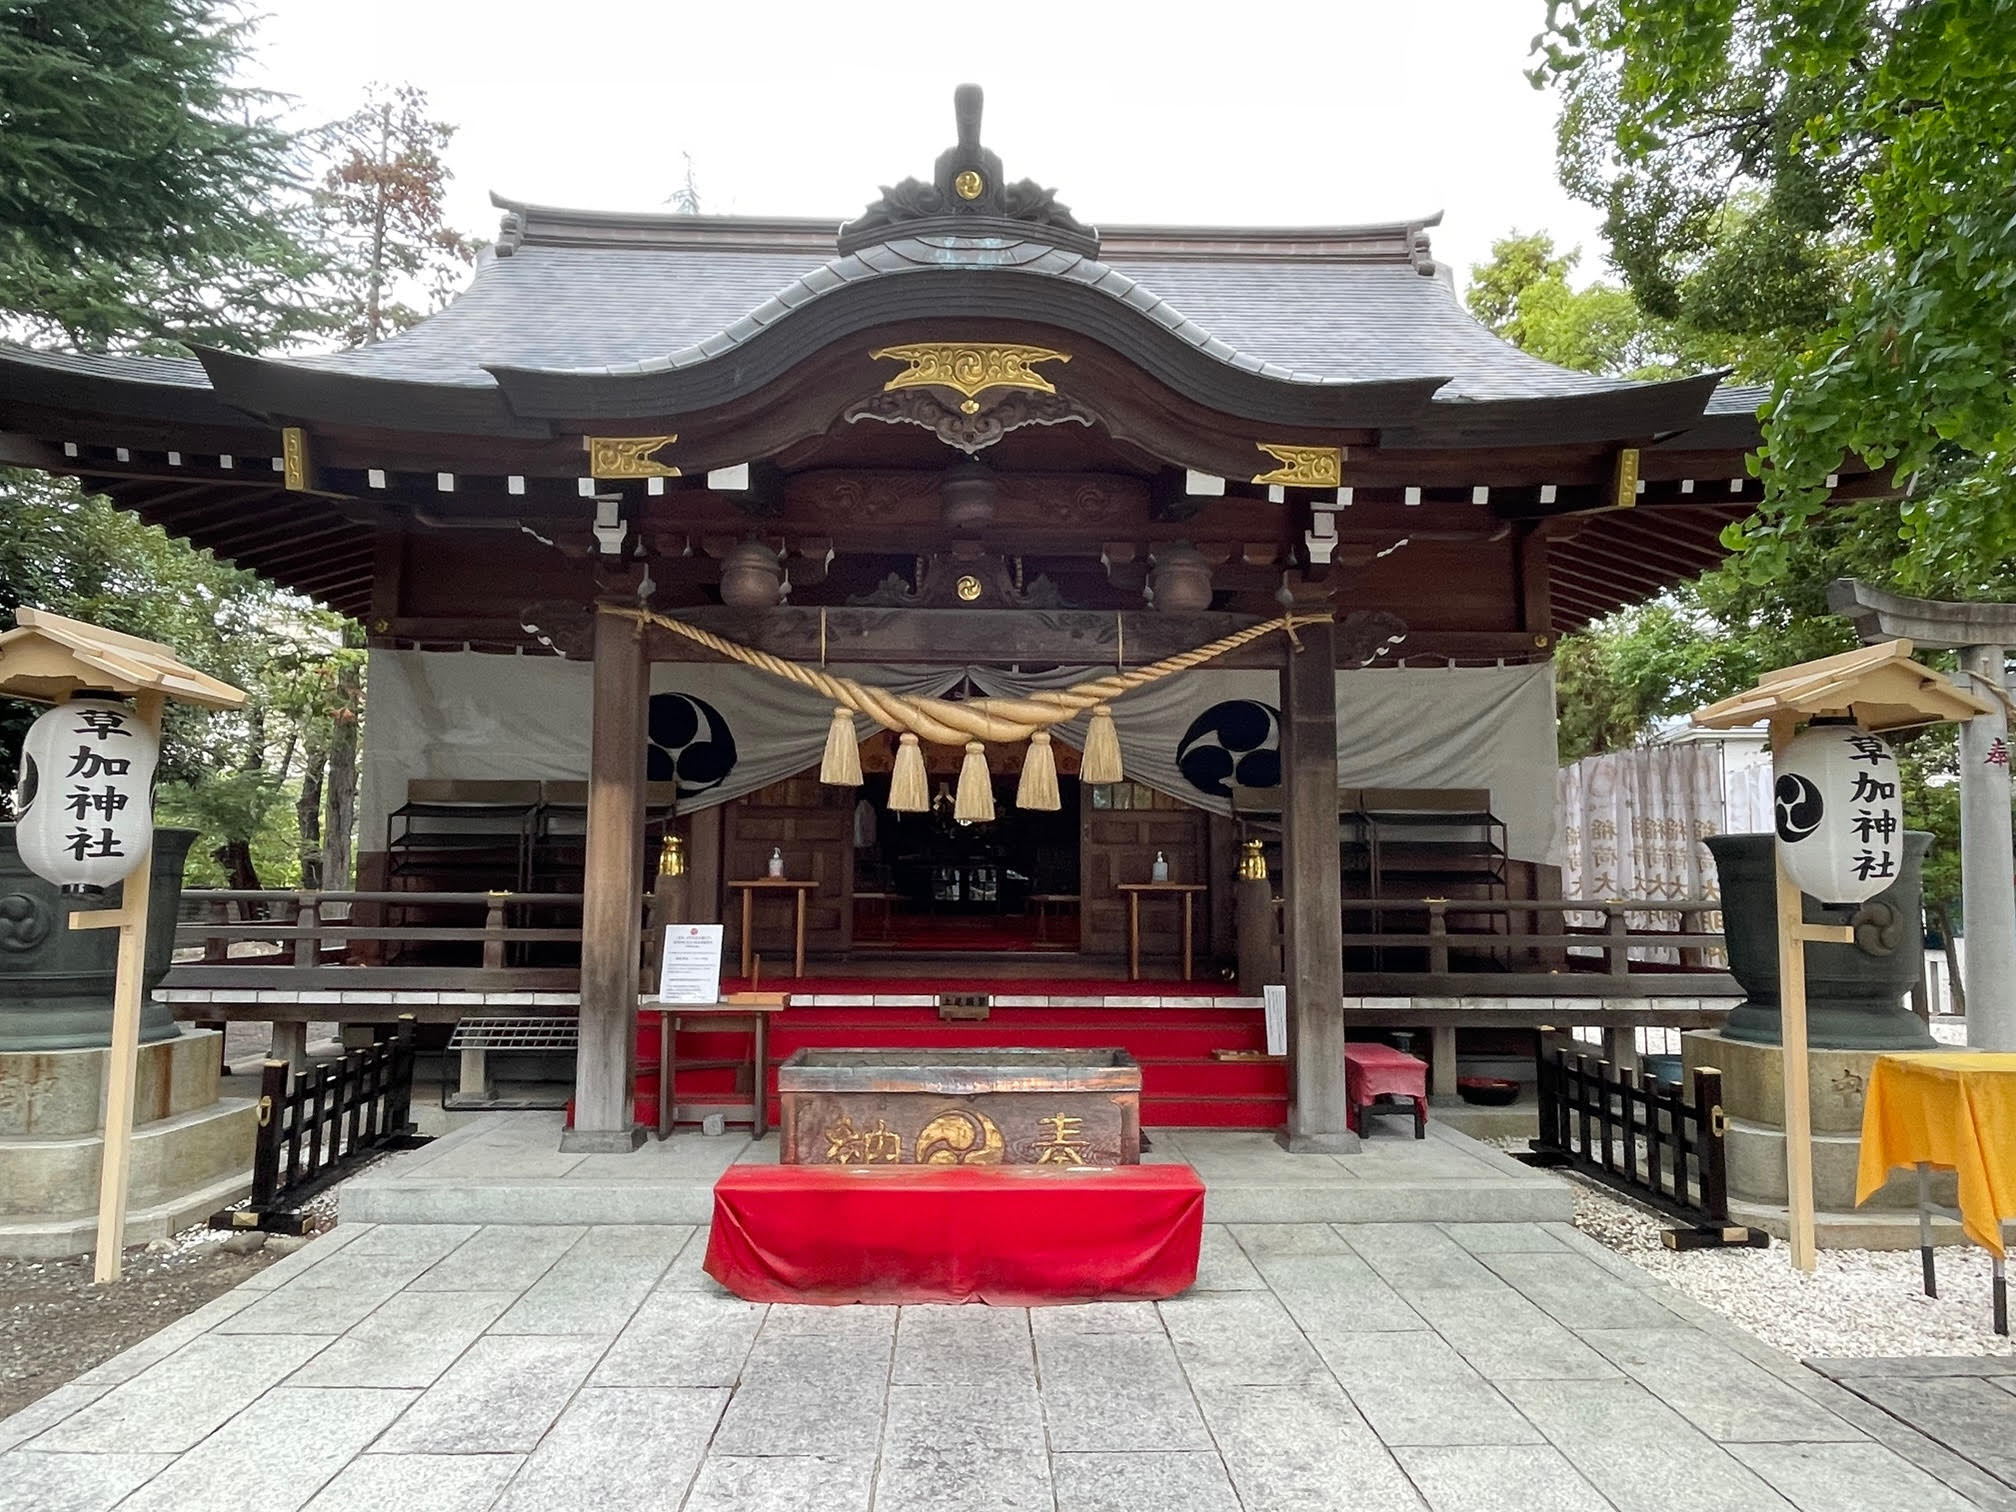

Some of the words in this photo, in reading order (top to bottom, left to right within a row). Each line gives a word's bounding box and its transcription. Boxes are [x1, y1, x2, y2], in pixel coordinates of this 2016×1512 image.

[64, 709, 132, 861] 草加神社
[1843, 735, 1897, 882] 草加神社
